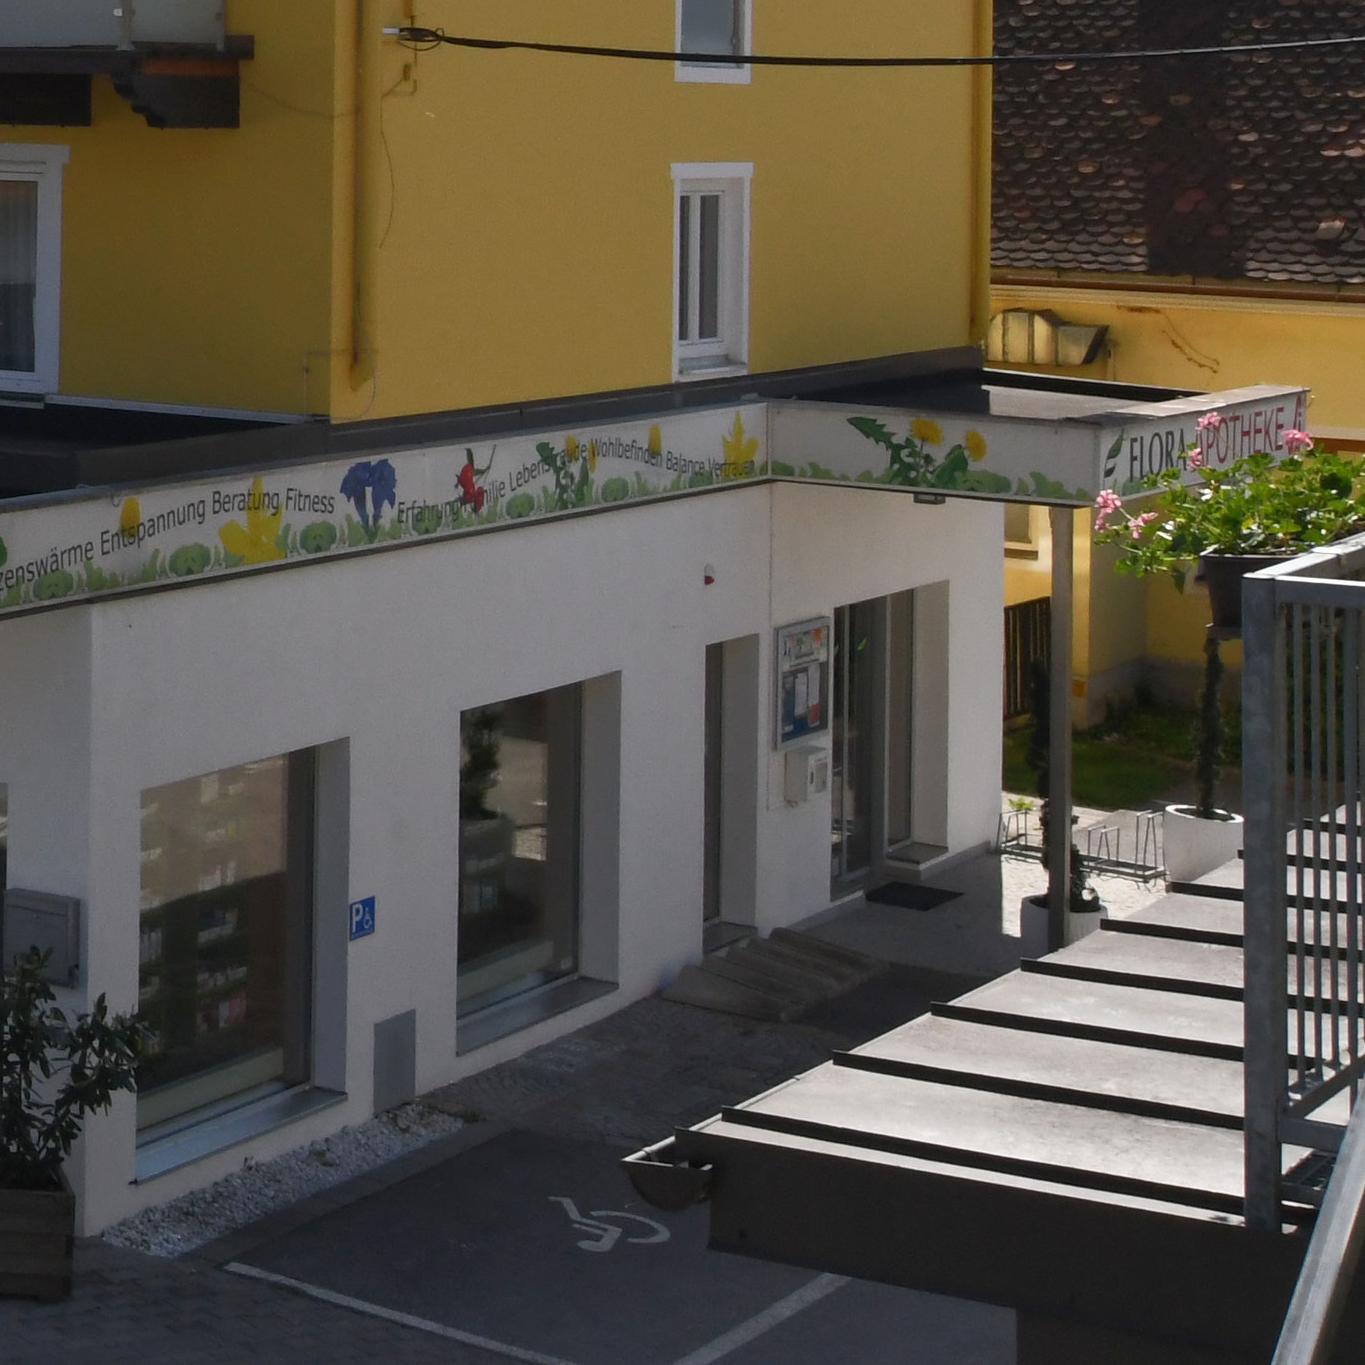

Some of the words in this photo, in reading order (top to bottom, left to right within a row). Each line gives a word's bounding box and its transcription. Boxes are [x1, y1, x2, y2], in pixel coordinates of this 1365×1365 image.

[1129, 428, 1187, 482] FLORA
[101, 499, 205, 555] Entspannung
[212, 490, 280, 516] Beratung
[285, 488, 335, 514] Fitness
[591, 438, 662, 467] Wohlbefinden
[666, 451, 705, 476] Balance
[352, 903, 364, 933] P
